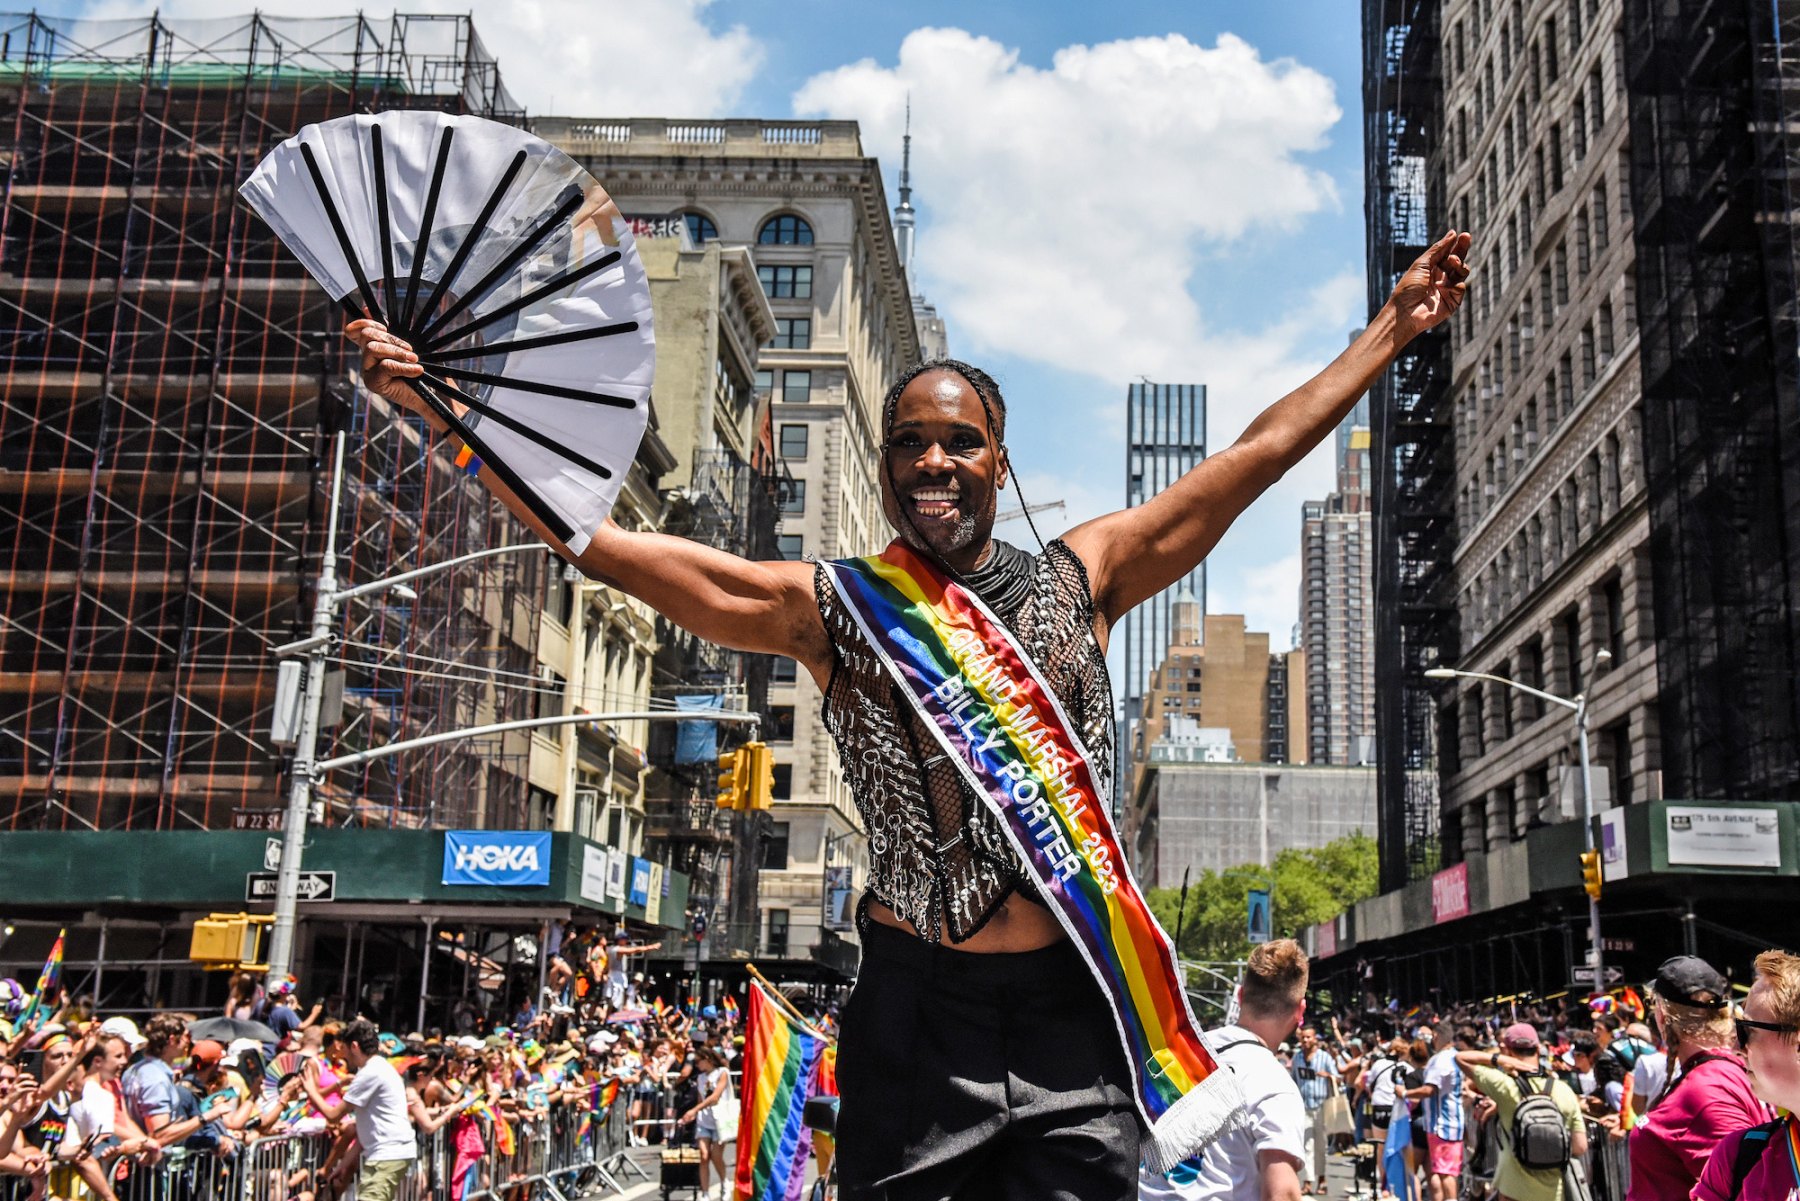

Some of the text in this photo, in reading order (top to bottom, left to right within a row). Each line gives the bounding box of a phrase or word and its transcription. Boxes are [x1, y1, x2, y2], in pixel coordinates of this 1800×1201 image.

[934, 675, 1082, 882] BILLY PORTER
[949, 629, 1119, 896] GRAND MARSHAL 2023
[236, 815, 247, 828] W
[250, 815, 263, 828] 22
[455, 845, 539, 871] HOKA
